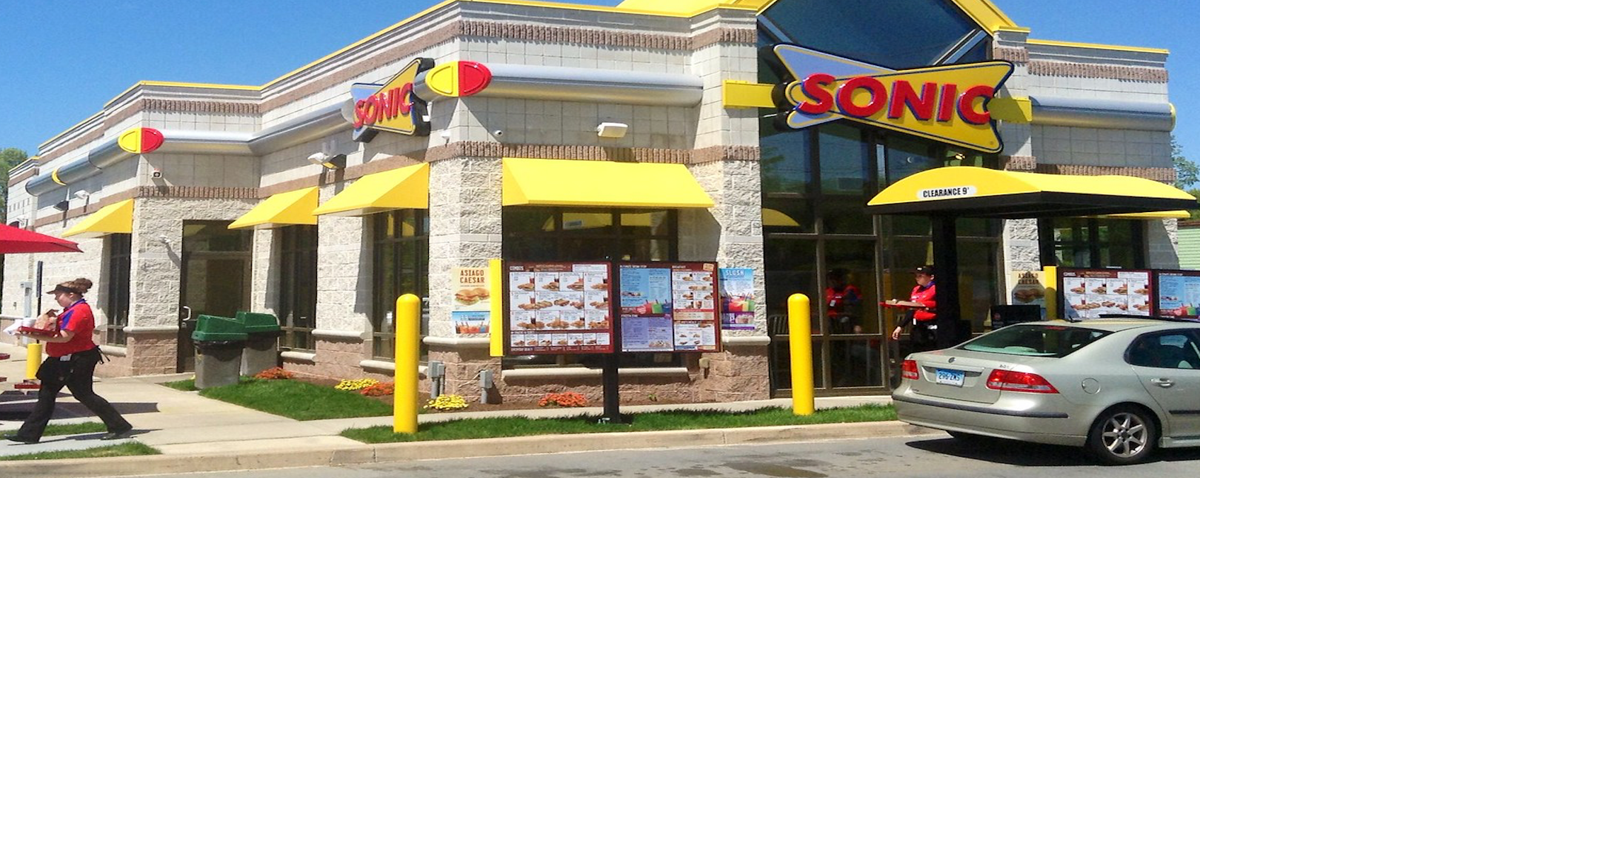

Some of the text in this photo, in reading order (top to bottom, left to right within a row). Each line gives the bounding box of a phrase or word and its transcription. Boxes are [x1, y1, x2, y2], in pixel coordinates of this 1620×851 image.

[796, 73, 996, 126] SONIC
[352, 82, 414, 129] SONIC
[922, 187, 961, 198] CLEARANCE
[460, 269, 485, 277] ASIAGO
[459, 276, 486, 284] CAESAR
